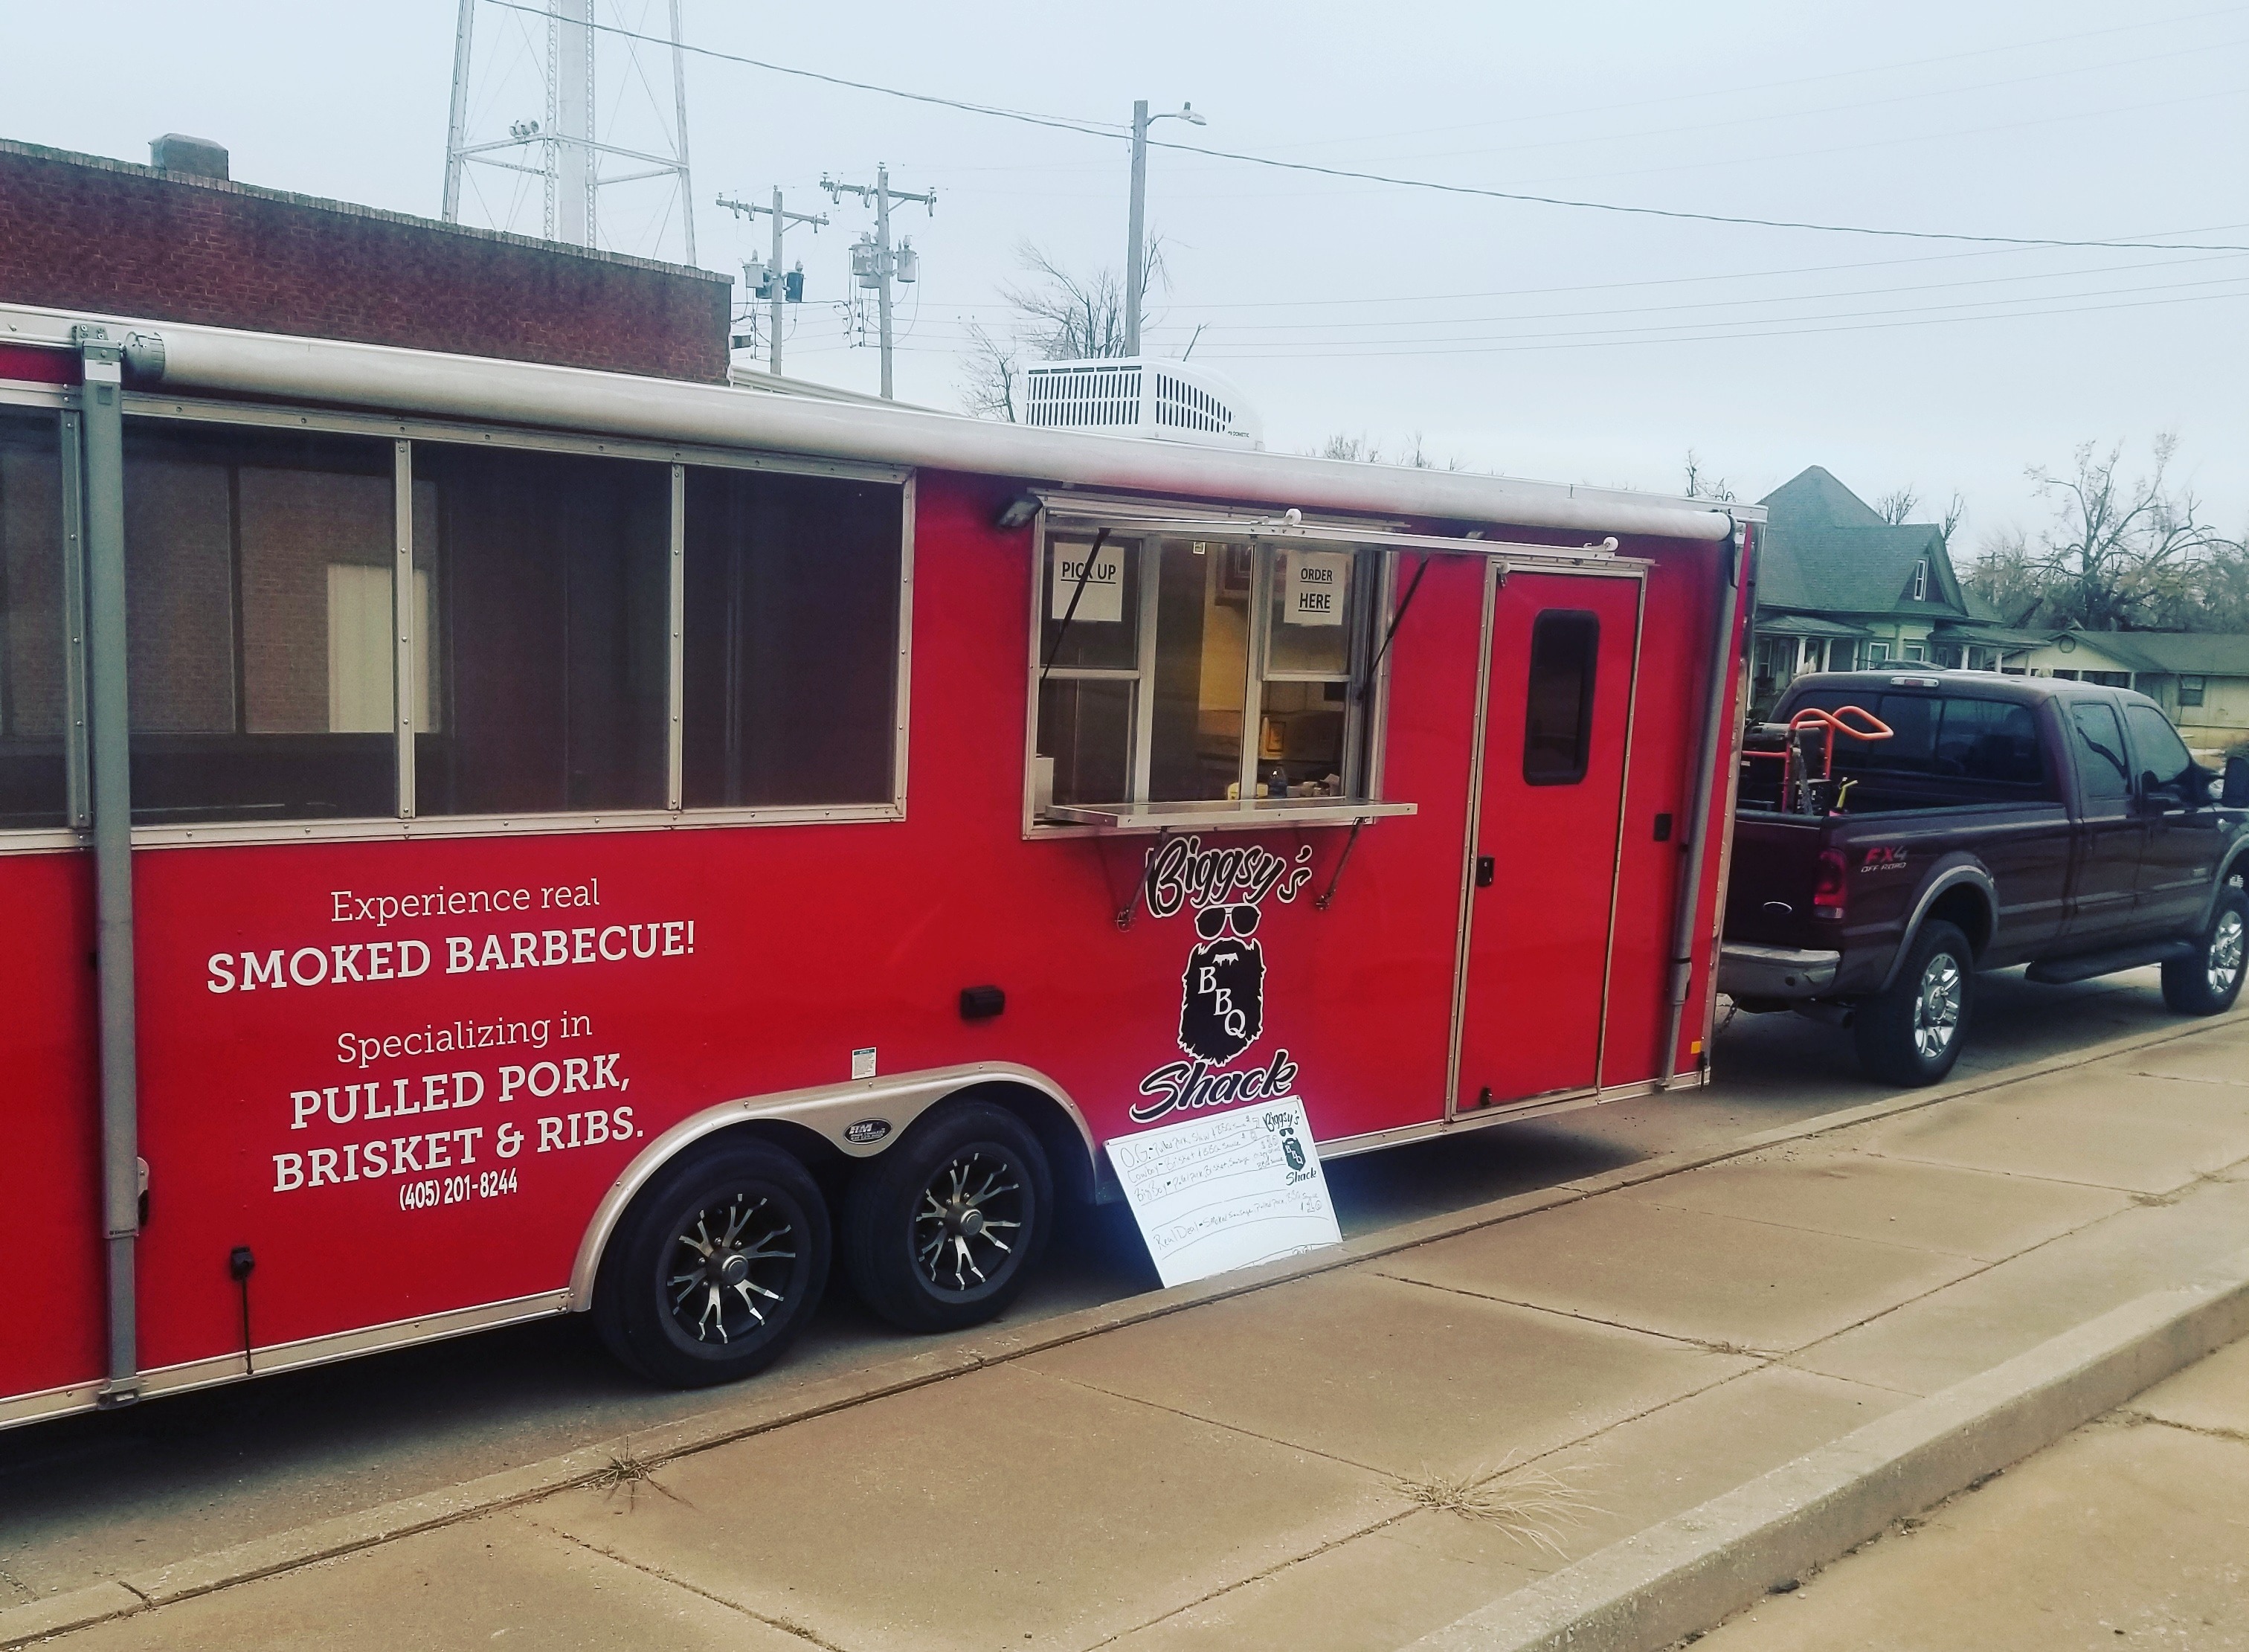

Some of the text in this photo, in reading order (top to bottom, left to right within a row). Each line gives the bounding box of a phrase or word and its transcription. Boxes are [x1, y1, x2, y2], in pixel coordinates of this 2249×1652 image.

[1062, 562, 1116, 580] PIC UP
[1301, 568, 1333, 582] ORDER
[1299, 592, 1331, 609] HERE
[1145, 835, 1313, 918] Biggsy's
[1865, 846, 1908, 864] FX4
[1881, 862, 1907, 870] ROAD
[330, 878, 600, 927] Experience real
[207, 920, 695, 994] SMOKED BARBECUE!
[337, 1011, 593, 1069] Specializing in
[290, 1053, 631, 1130] PULLED PORK,
[1129, 1048, 1299, 1125] Shack
[1262, 1111, 1300, 1132] Biggsy's
[272, 1107, 644, 1192] BRISKET & RIBS.
[399, 1168, 518, 1211] (405) 201-8244
[1286, 1167, 1316, 1186] Shack
